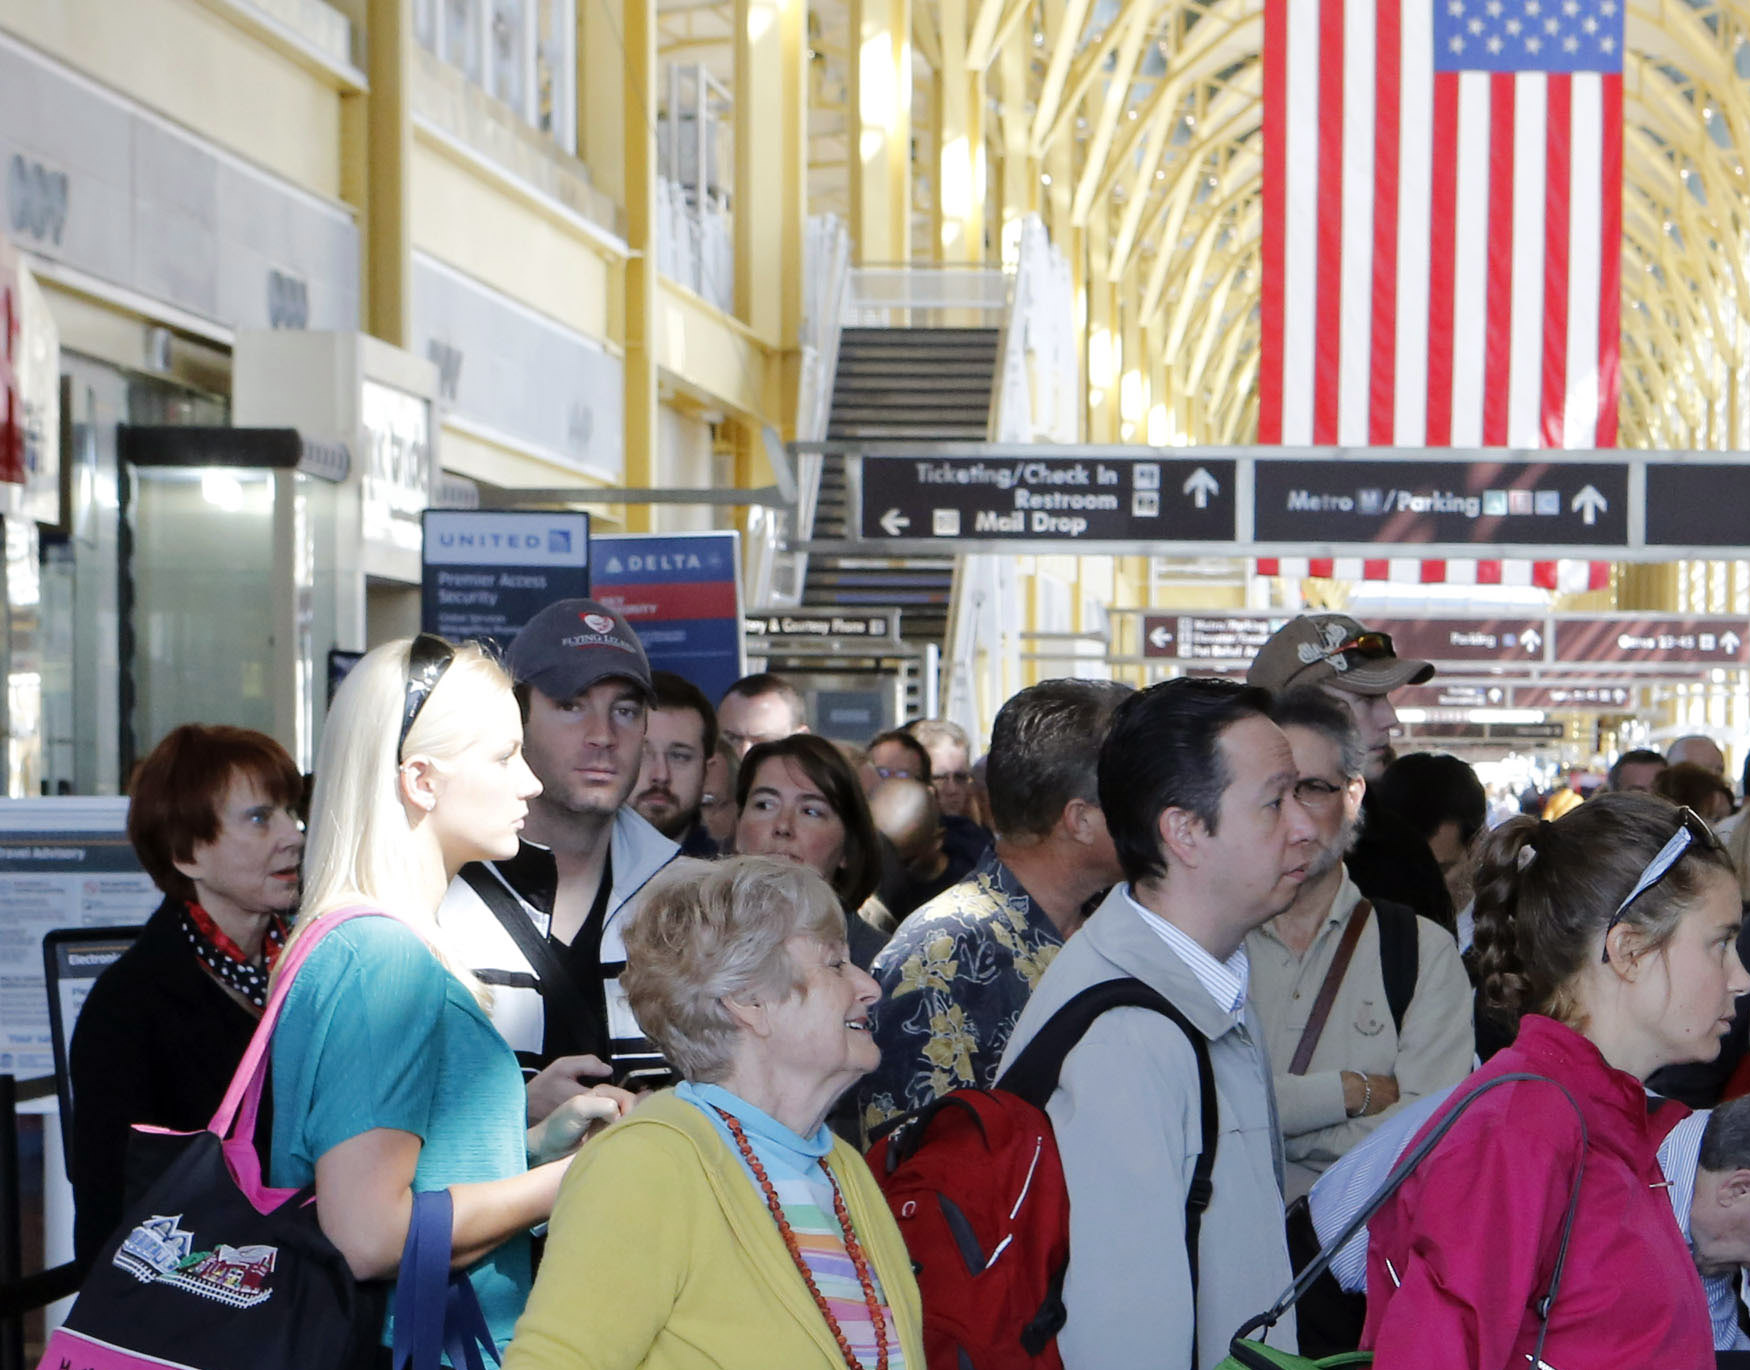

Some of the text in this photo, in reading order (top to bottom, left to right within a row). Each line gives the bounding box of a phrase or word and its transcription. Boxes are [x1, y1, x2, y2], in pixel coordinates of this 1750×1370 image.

[915, 462, 1118, 489] Ticketing/Check In
[1014, 488, 1118, 510] Restroom
[1287, 489, 1353, 512] Metro
[975, 511, 1088, 536] Mail Drop
[440, 533, 542, 549] UNITED
[628, 554, 701, 571] DELTA
[437, 571, 548, 589] Premier Access
[437, 588, 499, 606] Security
[561, 634, 602, 648] FLYING
